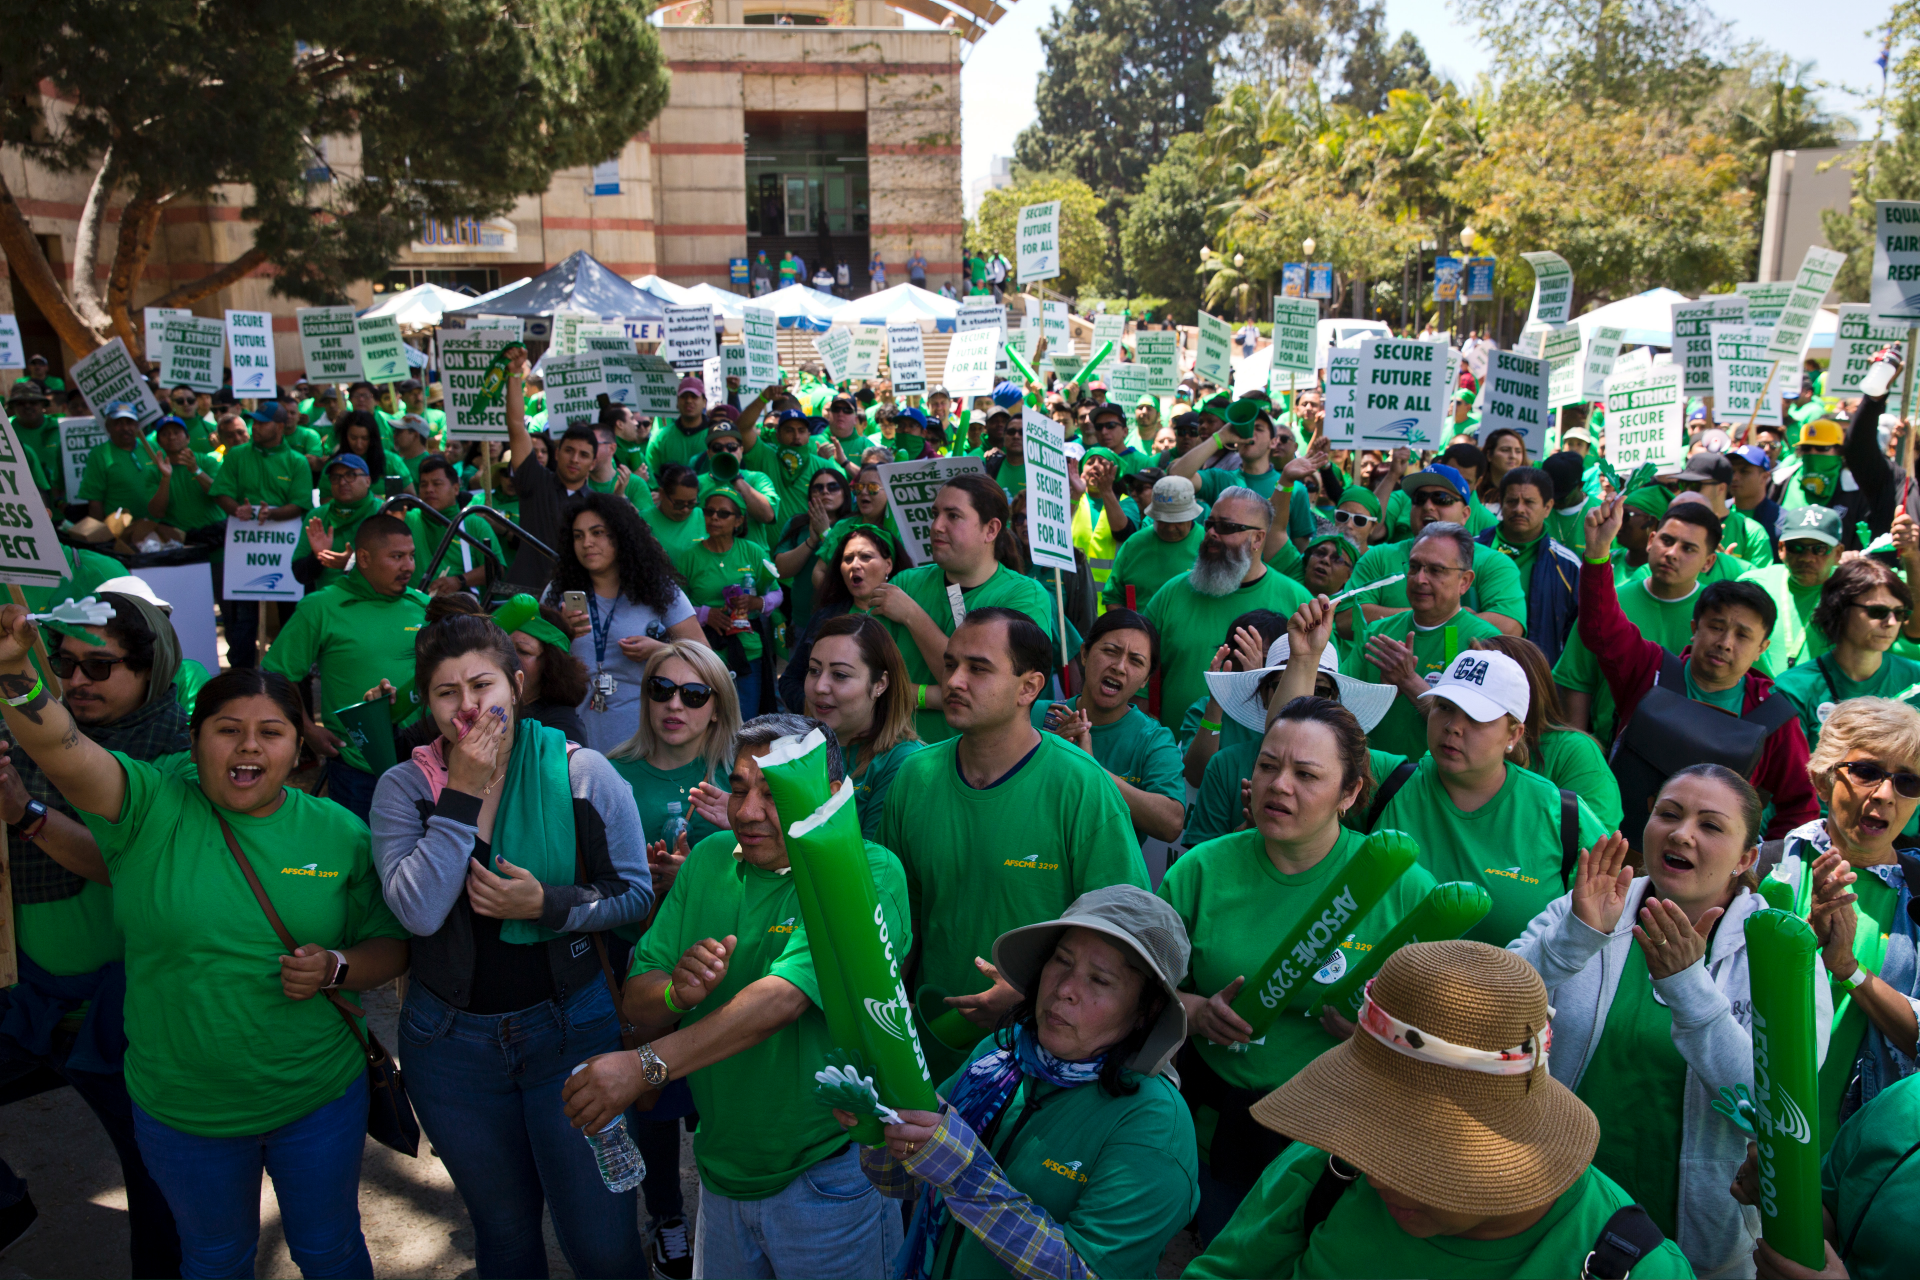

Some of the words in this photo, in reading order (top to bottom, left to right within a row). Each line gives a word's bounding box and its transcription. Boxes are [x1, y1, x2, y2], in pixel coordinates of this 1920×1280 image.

[1026, 205, 1053, 220] SECURE
[1886, 207, 1920, 224] EQUA
[1024, 222, 1052, 237] FUTURE
[1023, 243, 1037, 255] FOR
[1041, 240, 1053, 252] ALL
[1887, 235, 1920, 252] FAIR
[1888, 265, 1920, 281] RESP
[665, 306, 710, 314] Community
[957, 308, 1003, 317] Community
[1043, 302, 1055, 313] AFE
[1676, 307, 1716, 318] AFSCME
[232, 314, 264, 328] SECURE
[677, 315, 708, 323] student
[970, 317, 1001, 325] student
[1033, 317, 1065, 330] STFFING
[1282, 327, 1309, 340] SECURE
[1676, 322, 1696, 336] ON
[1841, 324, 1864, 338] ON
[1867, 325, 1910, 341] STRIK
[167, 330, 183, 341] ON
[186, 333, 221, 346] STRIKE
[234, 334, 266, 348] FUTURE
[320, 337, 342, 348] SAFE
[669, 337, 711, 348] Equality
[960, 331, 990, 343] SECURE
[1201, 329, 1228, 349] STAFFING
[1717, 333, 1752, 341] AFSCME
[173, 345, 212, 358] SECURE
[443, 340, 482, 349] AFSCME
[957, 346, 988, 357] FUTURE
[1281, 340, 1308, 353] FUTURE
[311, 349, 354, 361] STAFFING
[679, 349, 704, 358] NOW!
[857, 351, 872, 359] NOW
[1205, 347, 1222, 361] NOW
[1279, 352, 1294, 362] FOR
[1296, 354, 1309, 364] ALL
[1373, 343, 1434, 362] SECURE
[1718, 345, 1736, 359] ON
[172, 357, 211, 370] FUTURE
[234, 354, 252, 367] FOR
[255, 355, 269, 368] ALL
[445, 353, 465, 367] ON
[893, 360, 921, 370] Equality
[952, 364, 969, 373] FOR
[973, 361, 988, 371] ALL
[1140, 357, 1173, 366] FIGHTING
[1497, 353, 1540, 377] SECURE
[323, 362, 347, 373] NOW
[752, 366, 774, 378] RESPECT
[1150, 367, 1164, 375] FOR
[1729, 364, 1768, 378] SECURE
[81, 377, 98, 394] ON
[96, 356, 130, 385] STRIKE
[170, 369, 191, 380] FOR
[195, 372, 213, 383] ALL
[547, 374, 564, 386] ON
[566, 370, 601, 384] STRIKE
[646, 373, 665, 384] SAFE
[901, 371, 918, 380] NOW!
[1332, 368, 1351, 384] ON
[1371, 369, 1432, 387] FUTURE
[1685, 371, 1710, 383] FOR
[91, 372, 135, 407] EQUALITY
[1495, 377, 1539, 400] FUTURE
[1609, 379, 1647, 392] AFSCME
[1651, 374, 1677, 386] 3299
[564, 386, 588, 399] SAFE
[640, 385, 676, 396] STAFFING
[650, 398, 671, 408] NOW
[1367, 394, 1399, 410] FOR
[1403, 396, 1432, 412] ALL
[1610, 393, 1629, 411] ON
[1631, 386, 1676, 408] STRIKE
[1728, 397, 1749, 409] FOR
[553, 400, 601, 414] STAFFING
[1490, 400, 1513, 419] FOR
[1518, 406, 1539, 424] ALL
[457, 411, 508, 426] RESPECT
[1619, 410, 1665, 428] SECURE
[1026, 421, 1049, 443] AFSCME
[1049, 432, 1063, 449] 3299
[1619, 428, 1665, 446] FUTURE
[67, 437, 85, 449] ON
[1028, 440, 1041, 461] ON
[1042, 447, 1066, 475] STRIKE
[1618, 449, 1640, 463] FOR
[1646, 446, 1666, 460] ALL
[889, 469, 941, 484] AFSCME
[946, 466, 979, 478] 3299
[1036, 472, 1063, 500] SECURE
[894, 485, 921, 502] ON
[1037, 497, 1065, 524] FUTURE
[233, 530, 296, 544] STAFFING
[1037, 522, 1055, 544] FOR
[1057, 529, 1068, 549] ALL
[246, 553, 282, 566] NOW
[1453, 656, 1489, 686] CA
[1003, 859, 1037, 869] AFSCME
[1038, 862, 1059, 871] 3299
[281, 867, 316, 877] AFSCME
[318, 870, 339, 878] 3299
[1484, 868, 1519, 880] AFSCME
[1520, 875, 1539, 885] 3299
[1290, 884, 1359, 969] AFSCME
[1354, 942, 1375, 952] 329
[1259, 959, 1302, 1009] 3299
[1042, 1158, 1078, 1180] AFSCME
